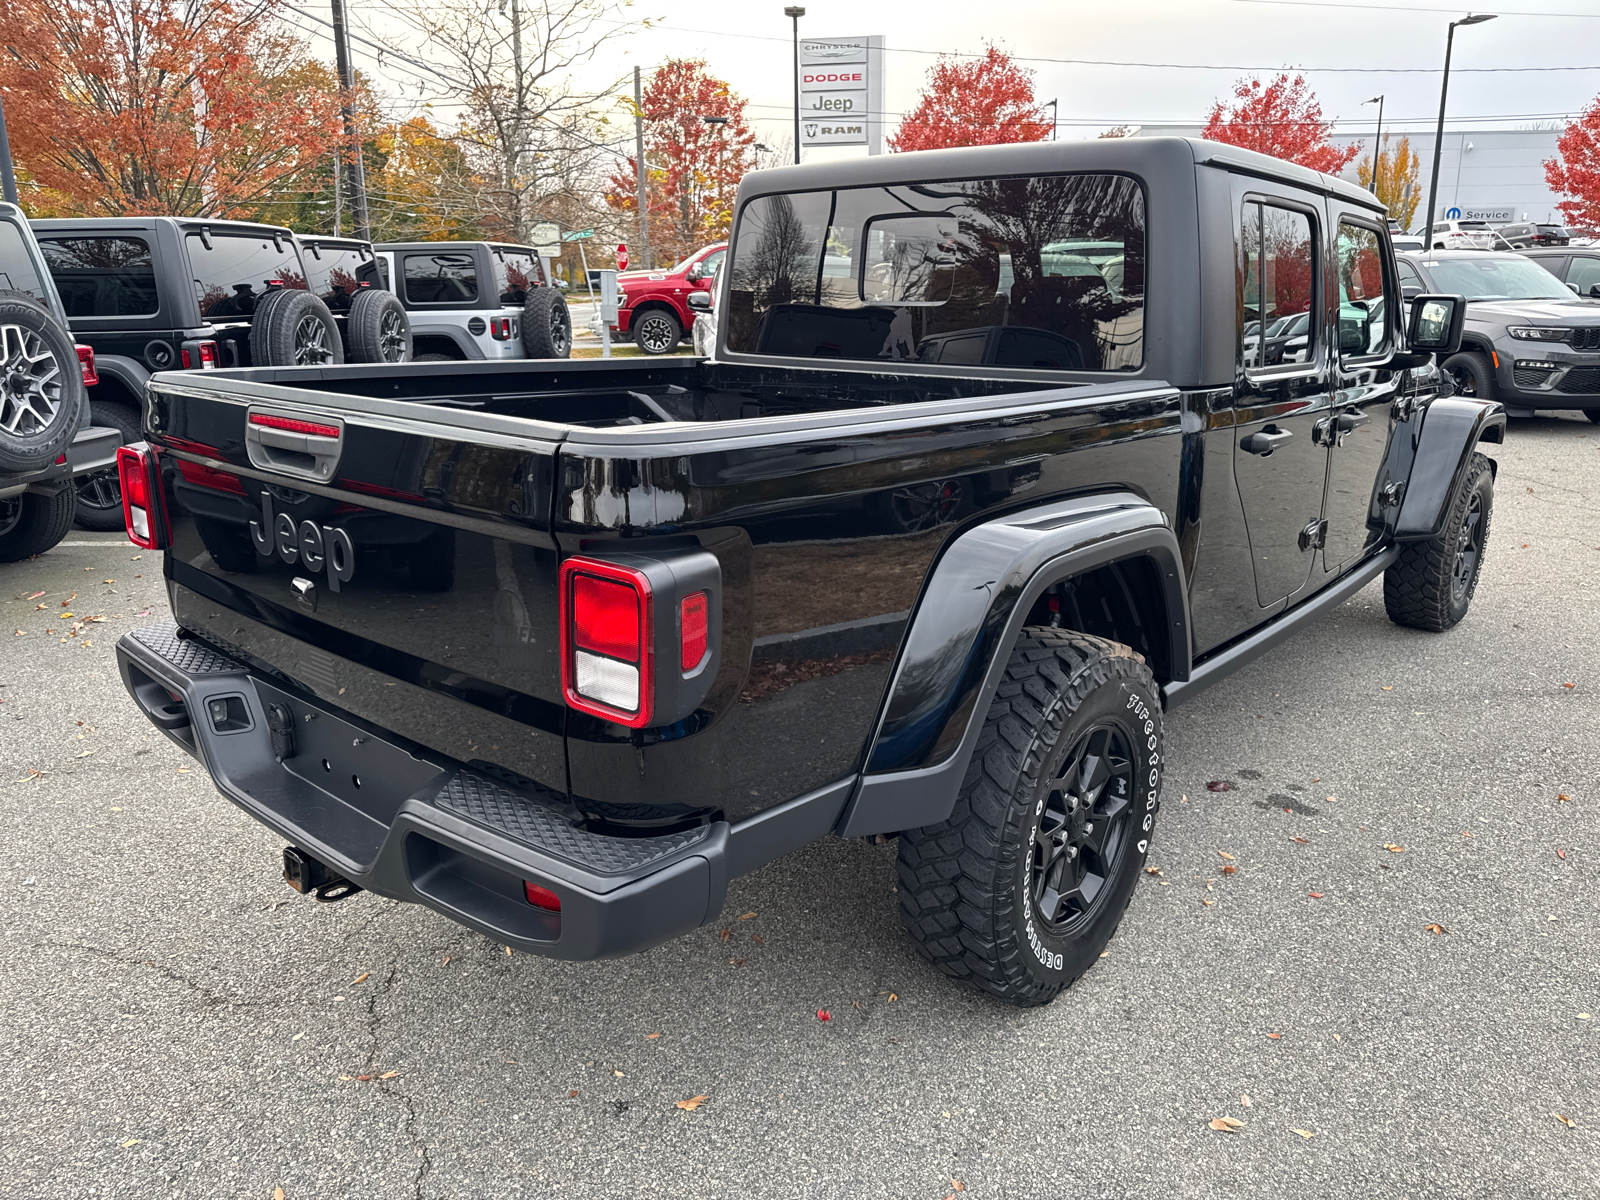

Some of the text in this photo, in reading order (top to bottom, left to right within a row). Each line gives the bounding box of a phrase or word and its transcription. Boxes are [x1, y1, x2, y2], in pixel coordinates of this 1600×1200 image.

[804, 43, 861, 51] CHRYSLER
[803, 73, 862, 83] DODGE
[812, 95, 853, 113] Jeep
[821, 126, 862, 135] RAM
[1466, 210, 1509, 219] Service
[249, 490, 355, 593] Jeep
